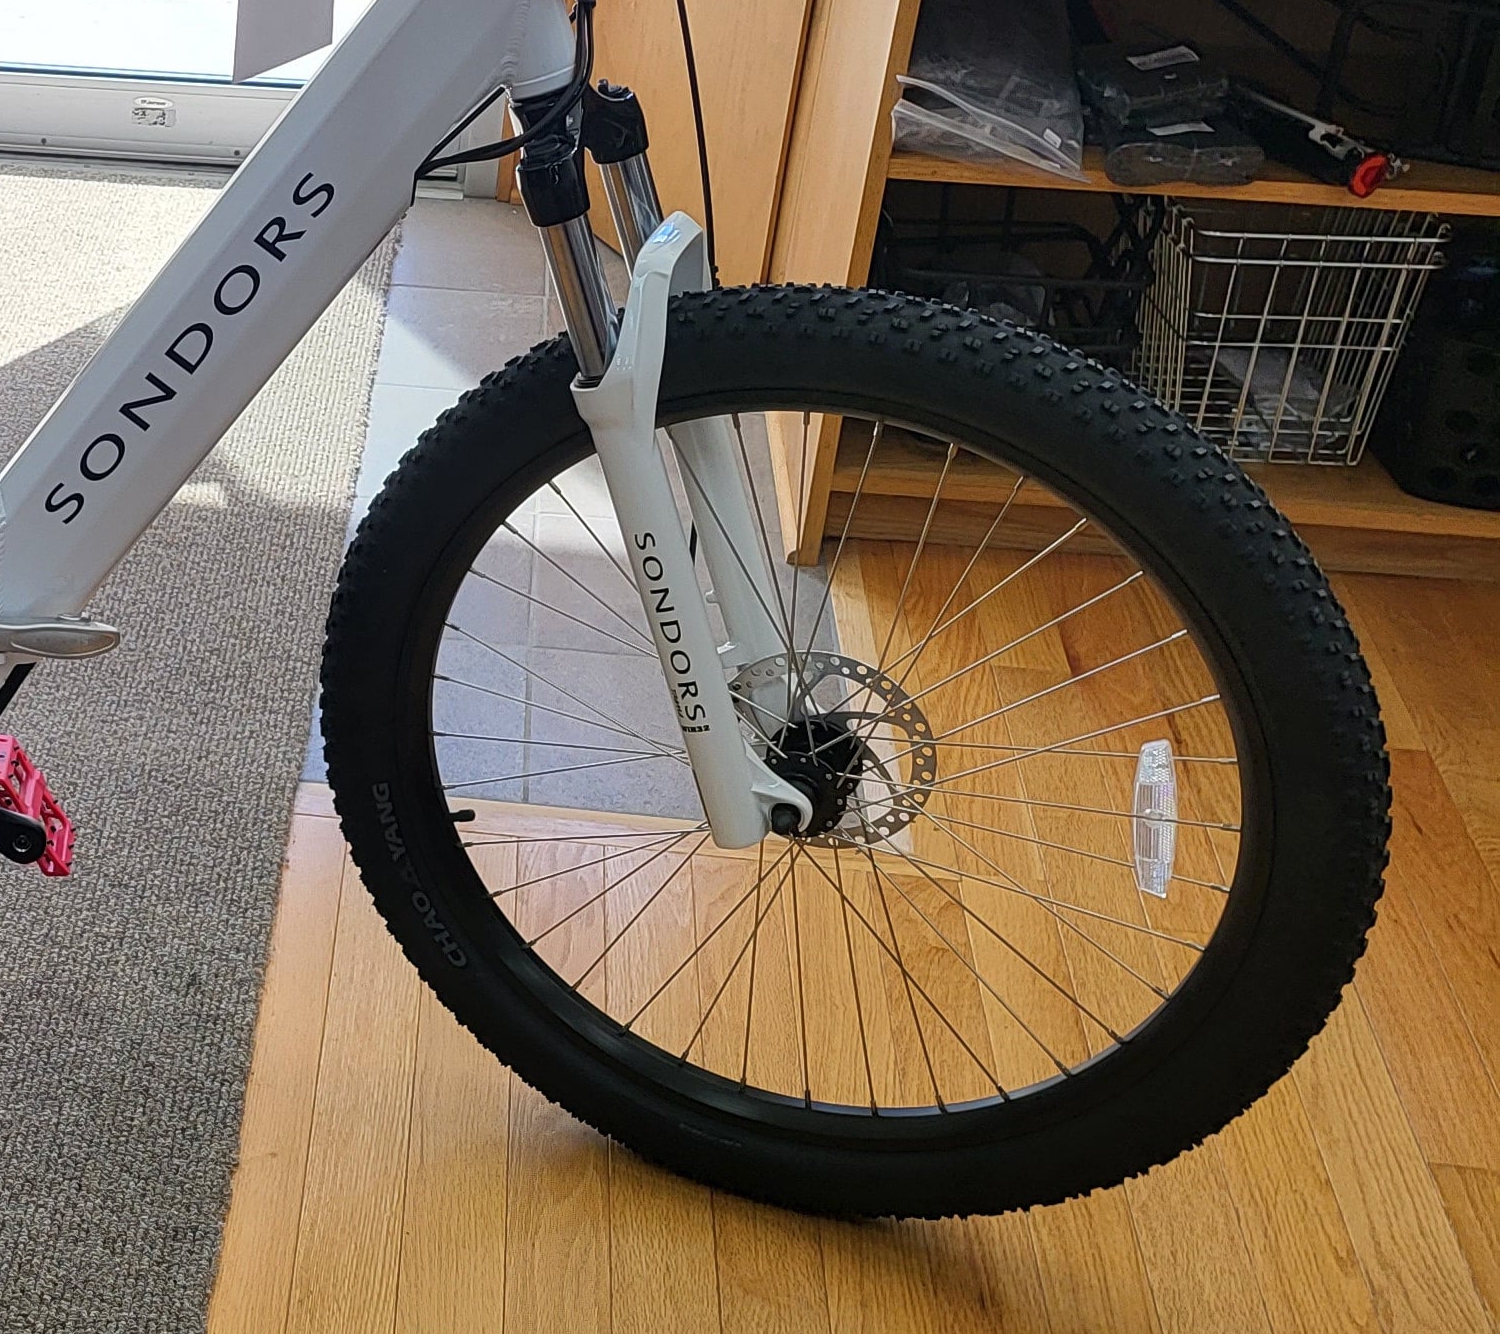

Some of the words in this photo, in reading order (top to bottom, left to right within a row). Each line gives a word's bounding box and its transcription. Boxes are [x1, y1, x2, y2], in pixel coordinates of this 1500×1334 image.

[44, 169, 336, 526] SONDORS
[633, 531, 706, 727] SONDORS
[371, 781, 409, 865] YANG
[410, 891, 468, 969] CHAO
